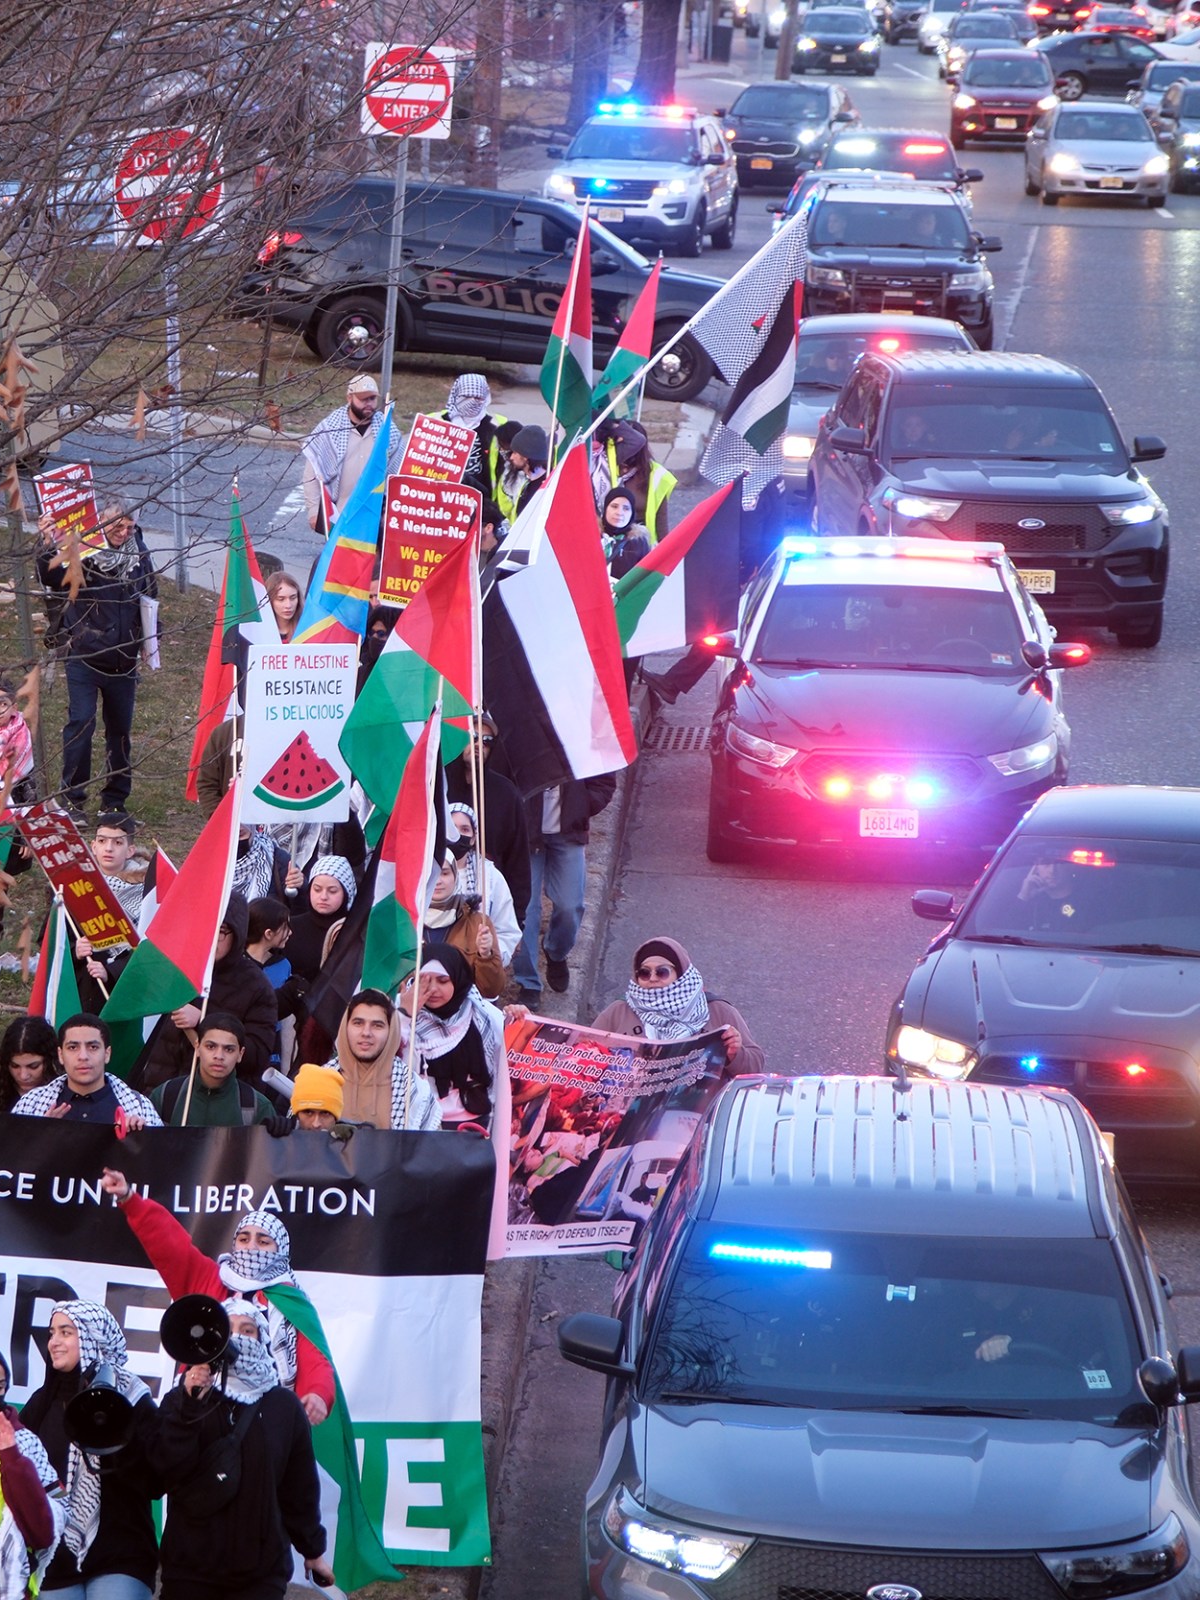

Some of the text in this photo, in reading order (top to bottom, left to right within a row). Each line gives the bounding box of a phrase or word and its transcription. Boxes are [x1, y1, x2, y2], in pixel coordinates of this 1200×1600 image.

[408, 64, 437, 79] NOT
[383, 103, 430, 119] ENTER
[426, 277, 599, 321] POLIC
[422, 418, 469, 440] Down With
[414, 428, 469, 452] Genocide Joe
[418, 441, 427, 450] &
[407, 448, 462, 475] fascist Trump
[410, 465, 449, 481] We Need
[400, 484, 473, 507] Down With
[391, 500, 471, 523] Genocide Jo
[389, 516, 467, 539] & Netan-Na
[400, 545, 447, 563] We Ne
[413, 564, 435, 579] RE
[386, 576, 424, 593] REVO
[382, 594, 408, 604] REVCOM
[261, 655, 349, 670] FREE PALESTINE
[265, 680, 342, 696] RESISTANCE
[266, 704, 345, 720] IS DELICIOUS
[864, 816, 915, 831] 16814MG
[40, 855, 55, 869] &
[68, 879, 94, 897] We
[93, 936, 125, 949] EVCOM.US
[542, 1041, 573, 1055] you're
[574, 1048, 592, 1059] not
[593, 1050, 631, 1067] careful,
[506, 1050, 532, 1064] have
[533, 1058, 551, 1068] you
[551, 1058, 584, 1074] hating
[585, 1064, 602, 1077] the
[602, 1069, 635, 1083] people
[508, 1066, 522, 1077] nd
[523, 1069, 550, 1084] loving
[551, 1072, 567, 1084] the
[567, 1078, 604, 1092] people
[604, 1084, 624, 1096] who
[173, 1183, 376, 1217] LIBERATION
[506, 1230, 515, 1242] AS
[515, 1229, 529, 1241] THE
[529, 1229, 555, 1242] RIGHT
[554, 1229, 564, 1240] TO
[565, 1227, 597, 1239] DEFEND
[880, 1587, 909, 1600] Ford
